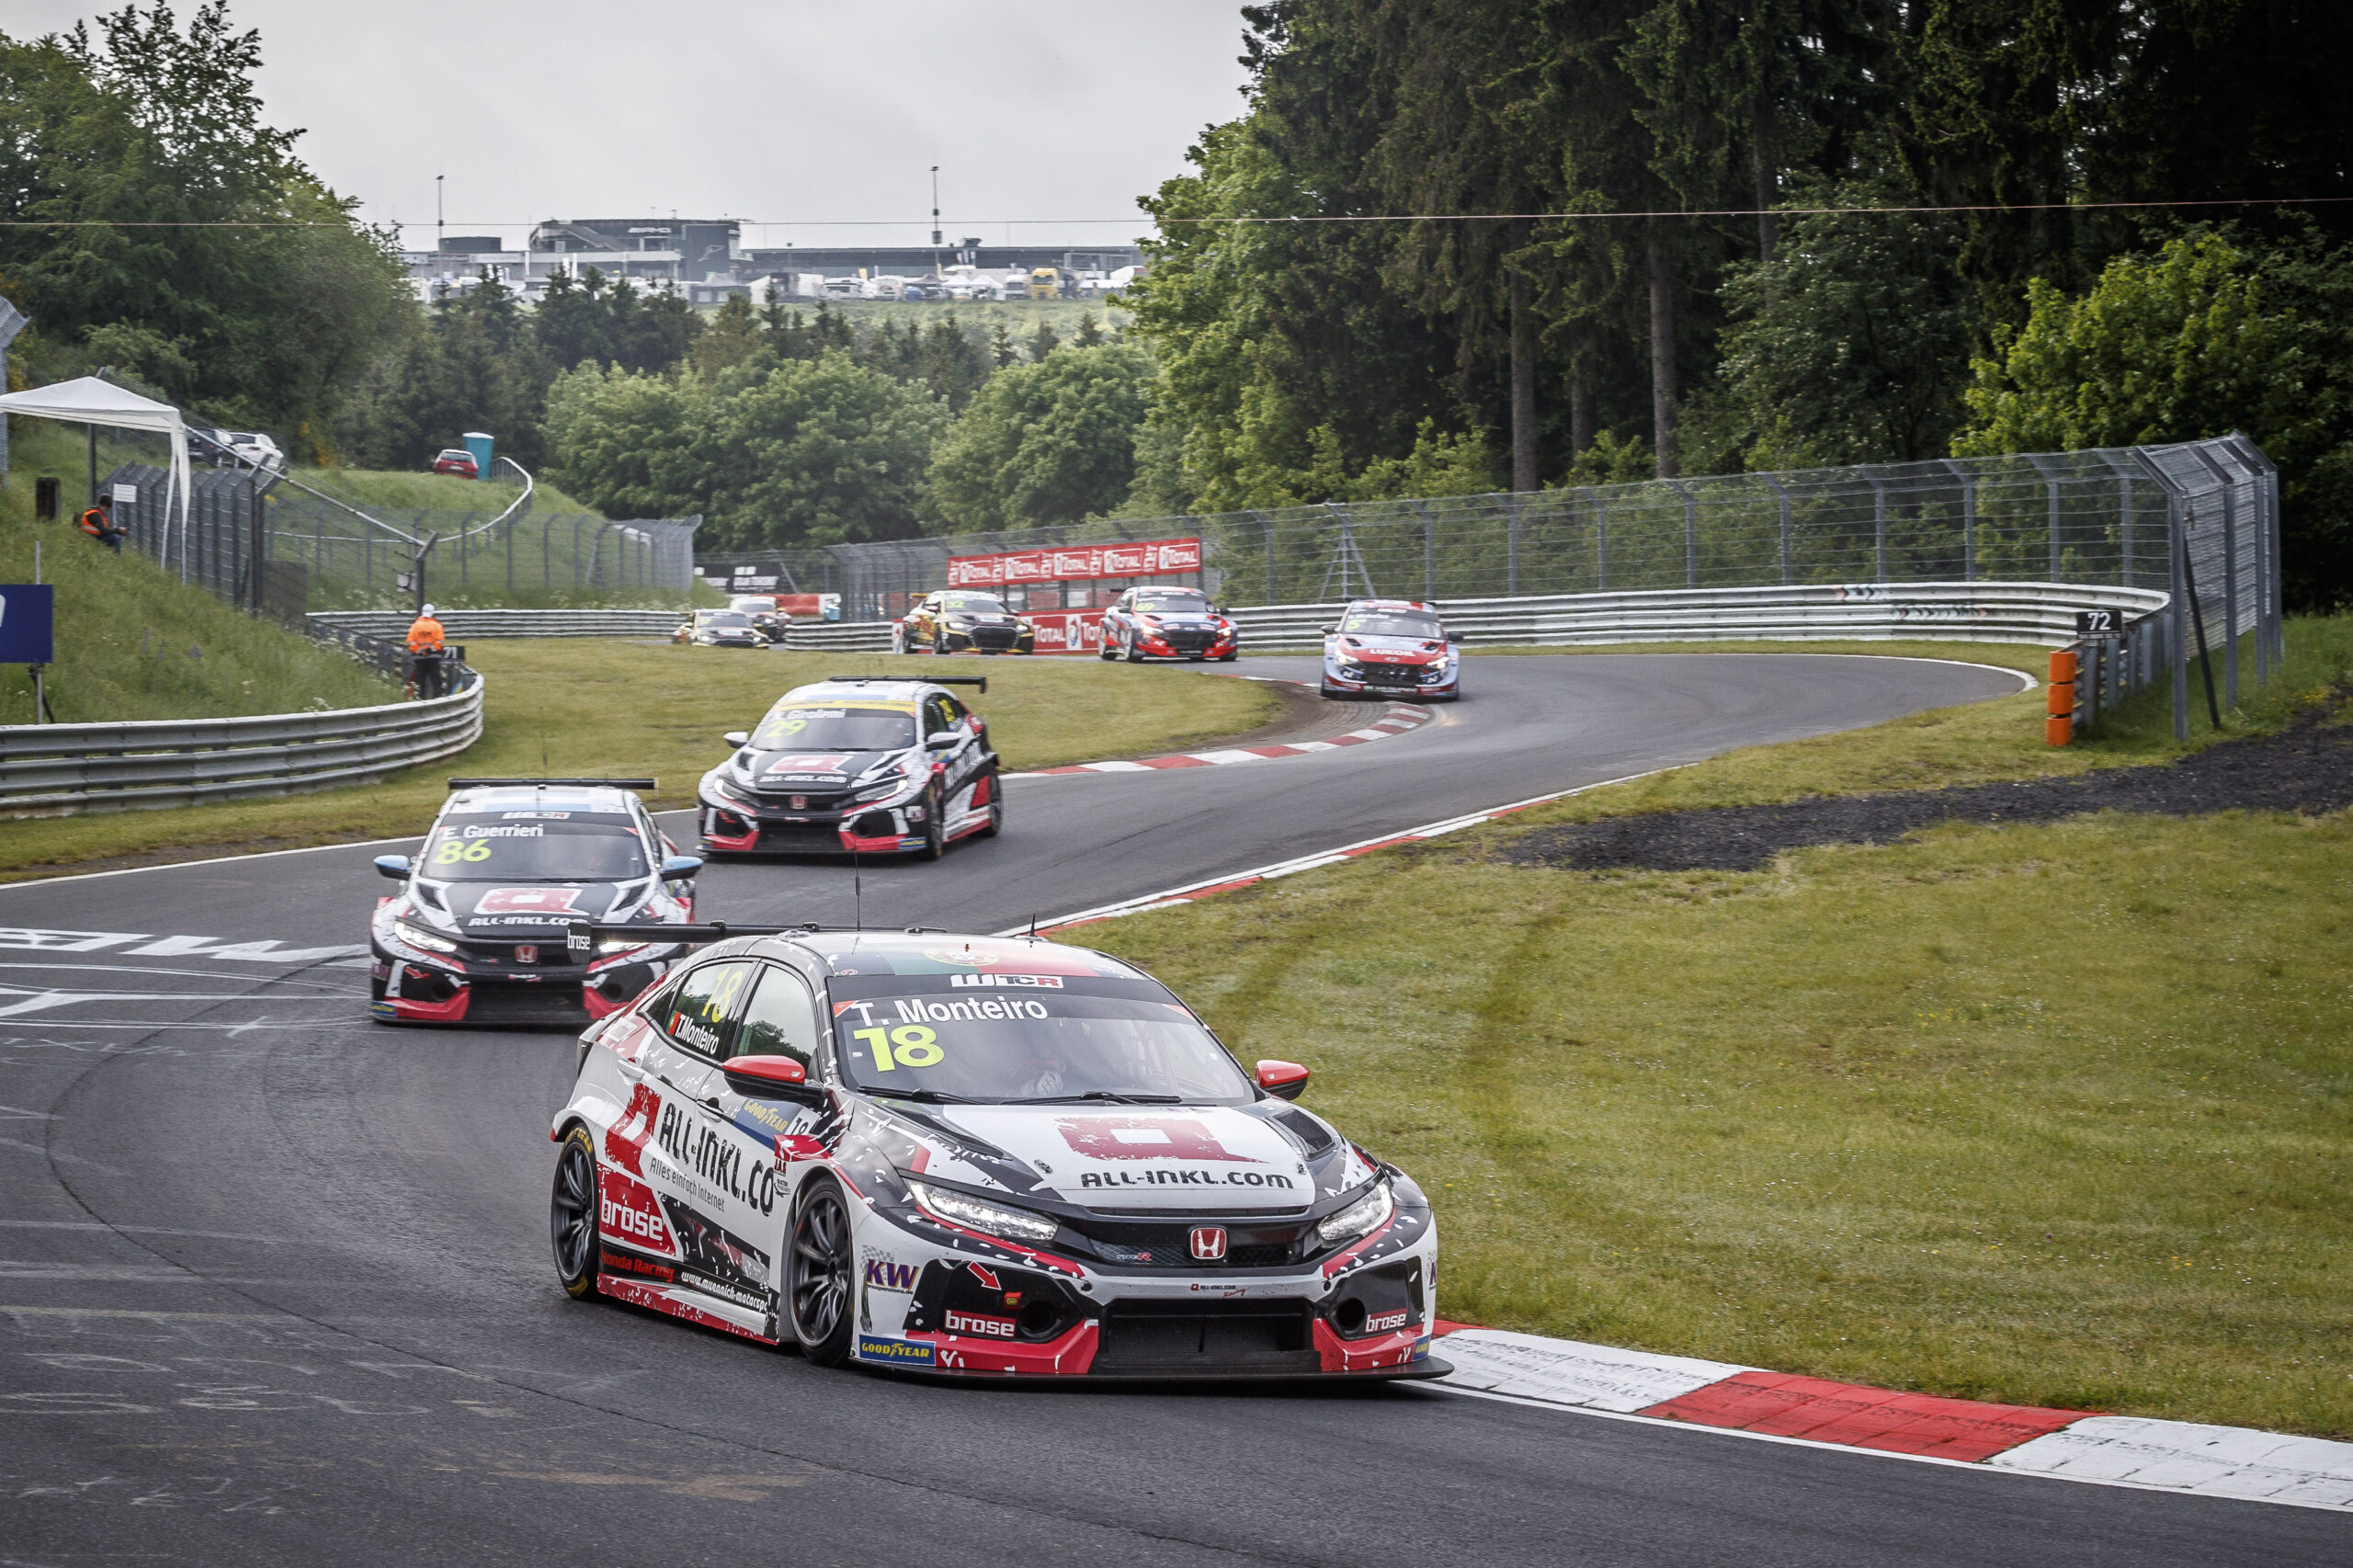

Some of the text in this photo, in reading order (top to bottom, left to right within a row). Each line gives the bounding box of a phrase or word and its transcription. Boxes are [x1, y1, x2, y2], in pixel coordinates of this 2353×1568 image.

[1033, 625, 1066, 642] TOTAL
[1082, 622, 1100, 641] TOT
[2087, 612, 2111, 630] 72
[443, 646, 457, 658] 71
[764, 720, 808, 738] 29
[437, 839, 492, 864] 86
[567, 929, 590, 949] brose
[701, 966, 743, 1023] 18
[850, 995, 1048, 1027] T. Monteiro
[853, 1025, 945, 1072] 18
[659, 1102, 773, 1217] ALL-INKL.co
[650, 1157, 670, 1181] Alles
[698, 1183, 724, 1212] Internet
[600, 1187, 663, 1241] brose
[600, 1249, 675, 1282] Honda Racing
[866, 1258, 919, 1290] KW
[945, 1309, 1015, 1337] brose
[1365, 1313, 1406, 1333] brose
